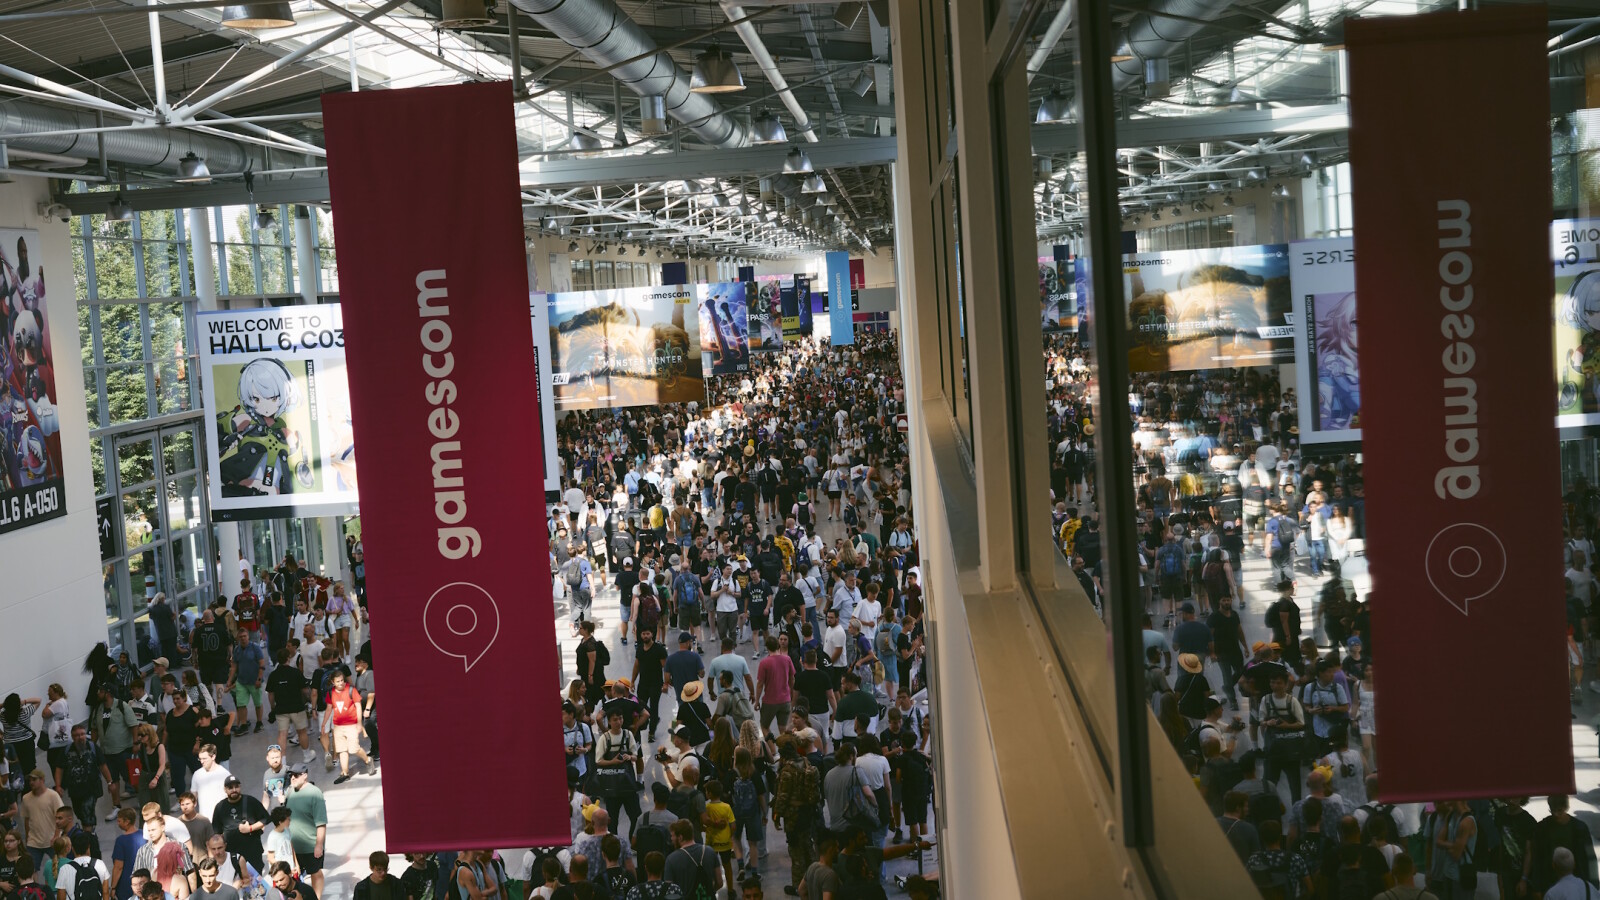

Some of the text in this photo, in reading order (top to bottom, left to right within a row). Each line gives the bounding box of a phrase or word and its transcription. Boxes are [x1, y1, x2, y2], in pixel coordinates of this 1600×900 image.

[642, 292, 690, 302] gamescom
[836, 272, 844, 309] gamescom
[208, 316, 322, 334] WELCOME TO
[210, 334, 272, 354] HALL
[603, 355, 682, 368] MONSTER HUNTER
[415, 268, 482, 560] gamescom
[24, 486, 58, 518] A-050
[201, 633, 219, 651] 10
